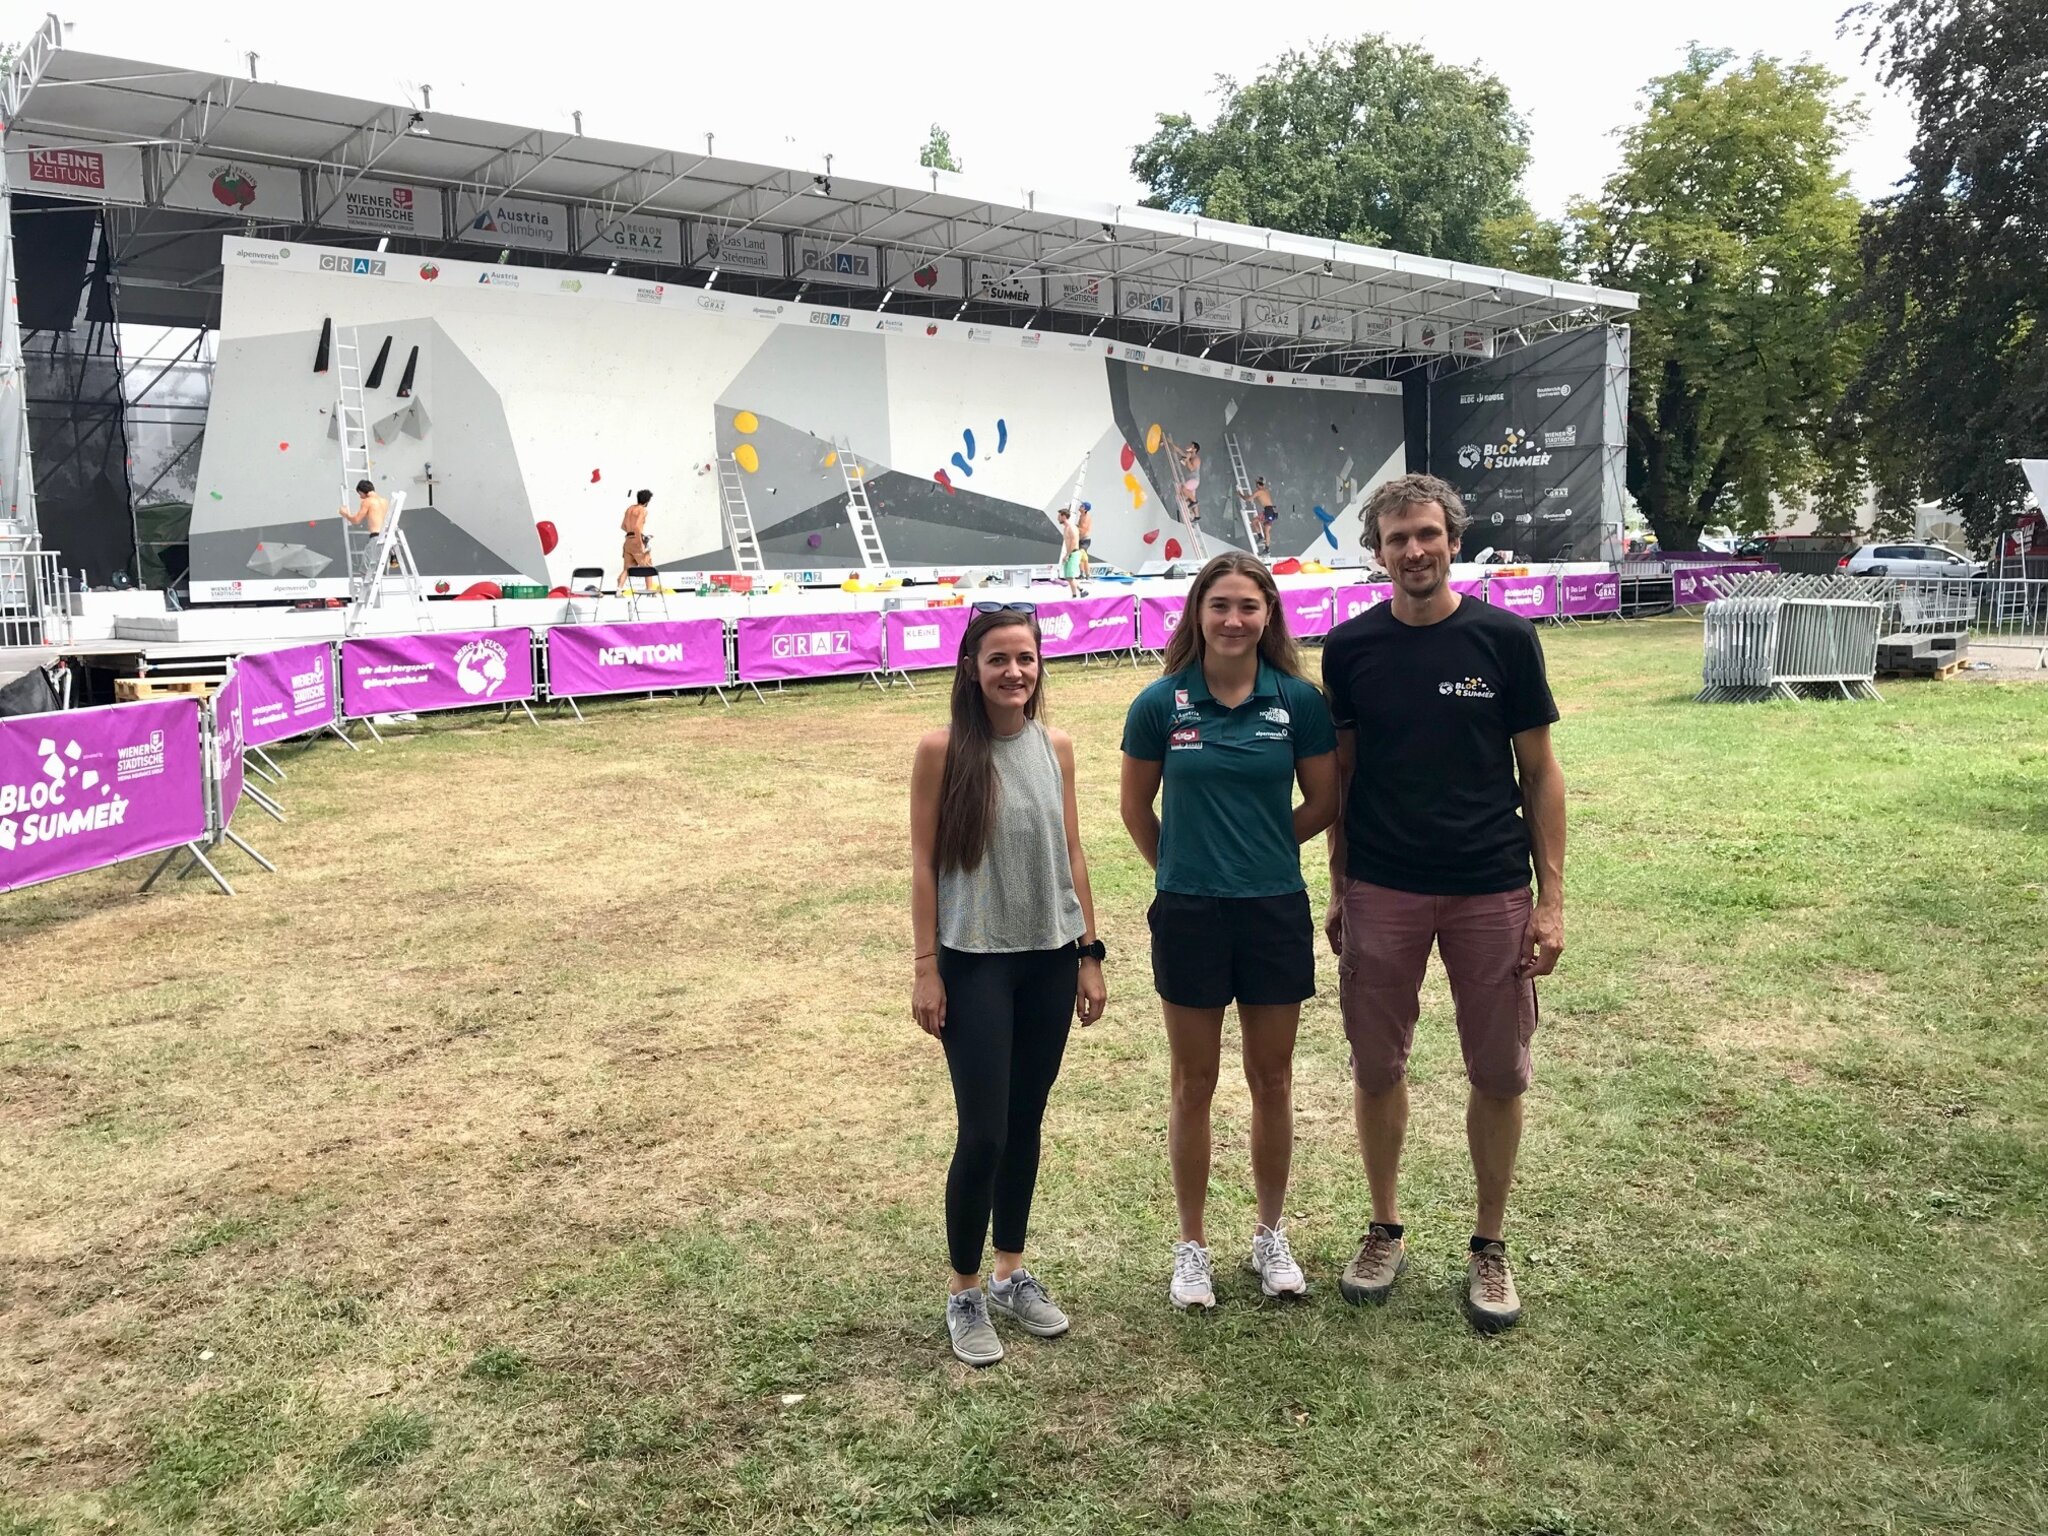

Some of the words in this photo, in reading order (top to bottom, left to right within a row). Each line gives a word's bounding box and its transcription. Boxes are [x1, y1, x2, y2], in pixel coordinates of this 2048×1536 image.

[33, 150, 99, 170] KLEINE
[34, 164, 100, 184] ZEITUNG
[346, 192, 392, 208] WIENER
[346, 204, 414, 222] STÄDTISCHE
[497, 208, 548, 225] Austria
[501, 221, 553, 241] Climbing
[627, 224, 662, 235] REGION
[614, 232, 662, 249] GRAZ
[744, 237, 765, 250] Land
[237, 249, 279, 260] alpenverein
[722, 252, 766, 266] Steiermark
[321, 256, 383, 275] GRAZ
[804, 252, 866, 274] GRAZ
[491, 272, 518, 280] Austria
[990, 287, 1029, 302] SUMMER
[704, 302, 725, 310] GRAZ
[810, 312, 849, 327] GRAZ
[1483, 443, 1517, 456] BLOC
[1495, 453, 1552, 468] SUMMER
[785, 572, 822, 583] GRAZ
[1599, 588, 1616, 597] GRAZ
[906, 628, 937, 637] KLEINE
[453, 642, 475, 663] BERG
[484, 639, 509, 660] FUCHS
[774, 634, 846, 656] GRAZ
[599, 643, 683, 666] NEWTON
[1455, 682, 1477, 690] BLOC
[1463, 690, 1495, 698] SUMMER
[118, 743, 150, 760] WIENER
[118, 752, 164, 772] STÄDTISCHE
[0, 777, 66, 816] BLOC
[21, 798, 129, 846] SUMMER
